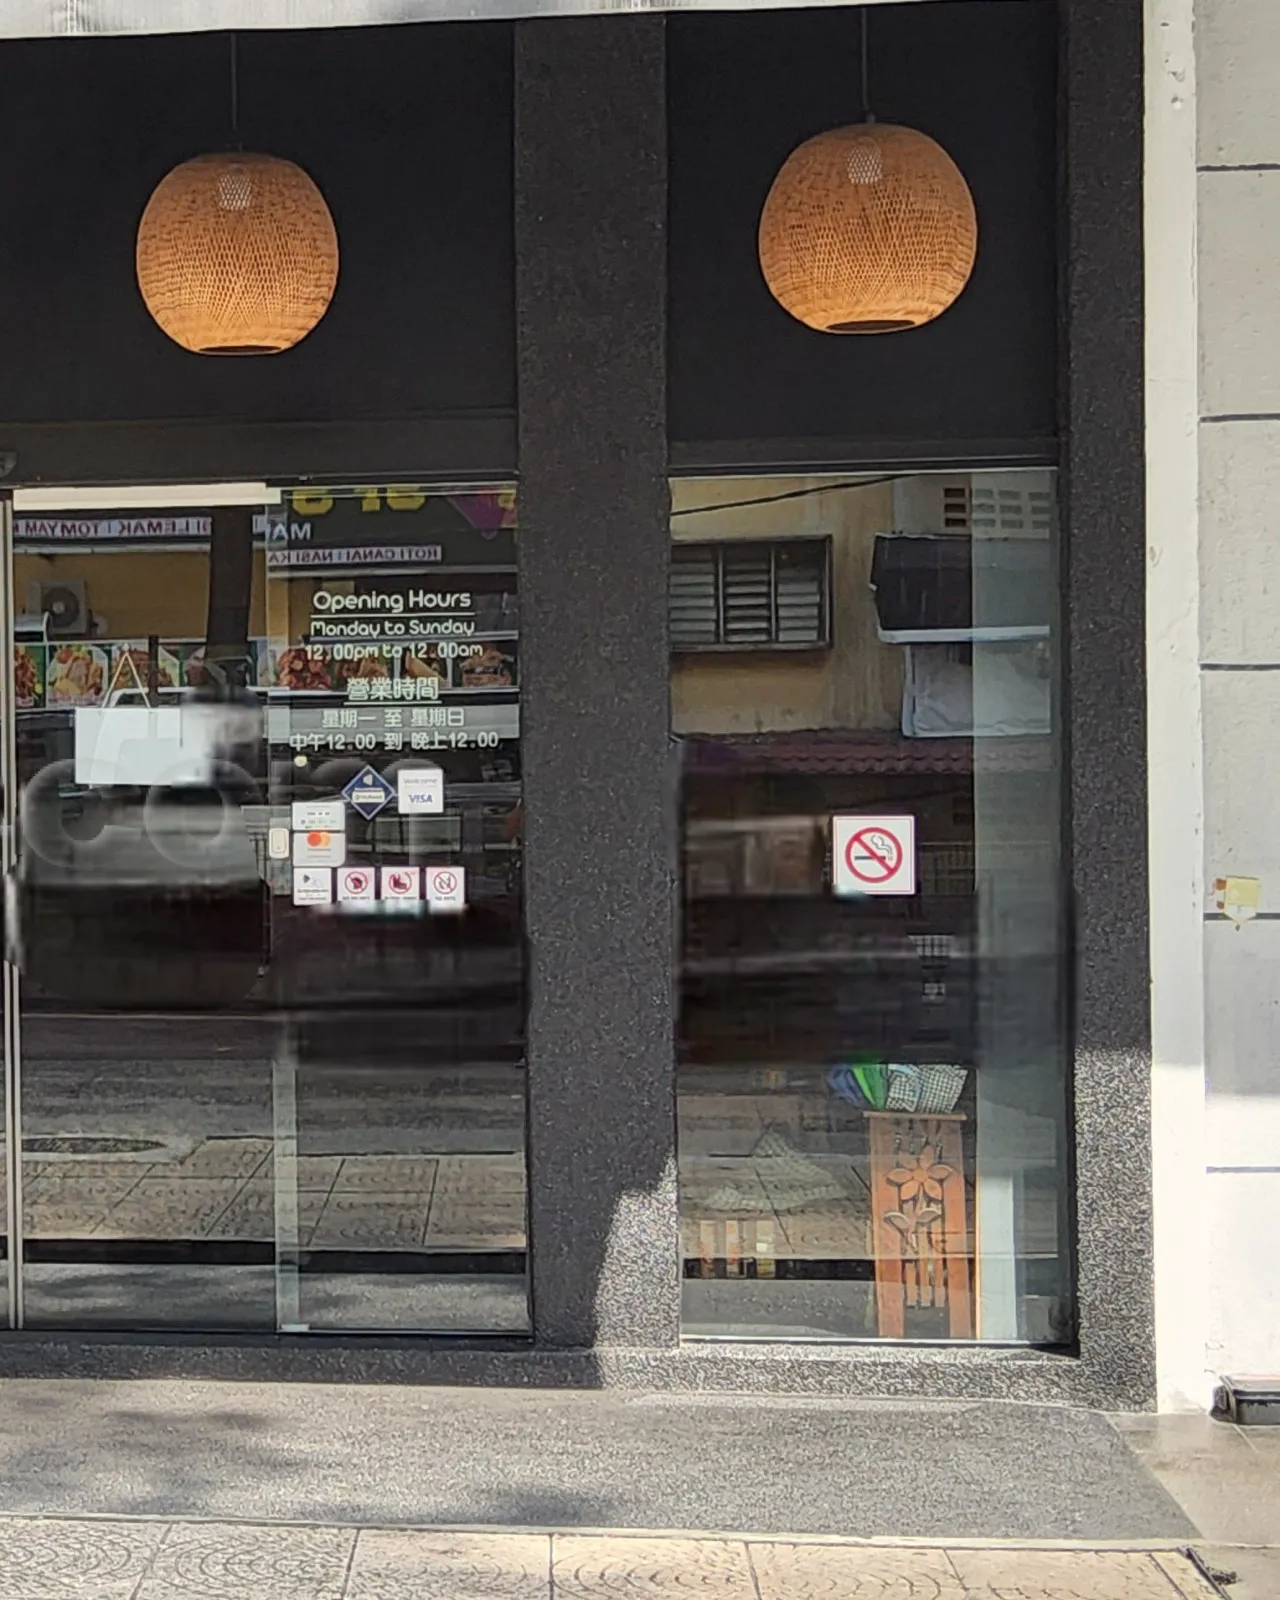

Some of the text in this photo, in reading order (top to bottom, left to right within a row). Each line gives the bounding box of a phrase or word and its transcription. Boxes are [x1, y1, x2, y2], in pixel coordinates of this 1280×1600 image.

[313, 589, 471, 614] Opening Hours
[310, 619, 475, 638] Monday to Sunday
[382, 643, 403, 659] to
[409, 642, 483, 659] 12.00am
[346, 676, 440, 701] 營業時間
[322, 707, 465, 729] 星期一 至 星期日
[384, 732, 402, 750] 到
[408, 794, 433, 804] VISA
